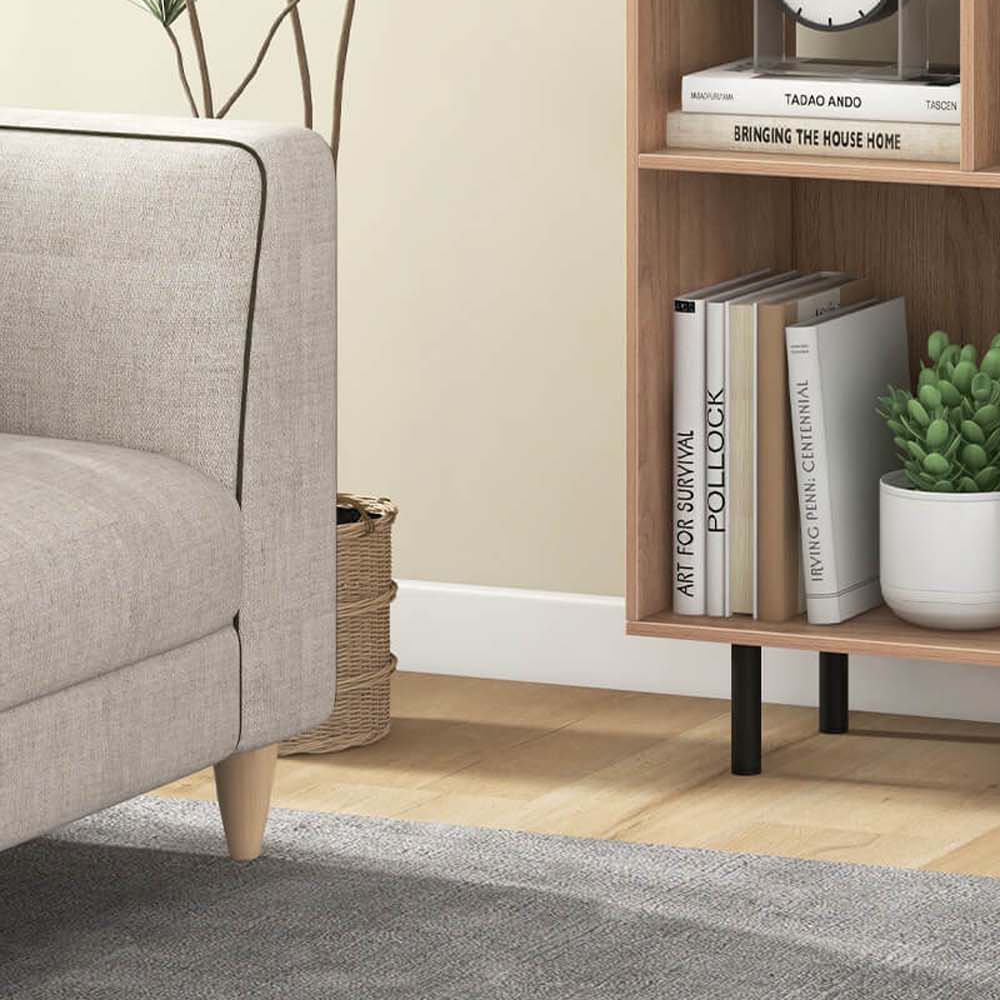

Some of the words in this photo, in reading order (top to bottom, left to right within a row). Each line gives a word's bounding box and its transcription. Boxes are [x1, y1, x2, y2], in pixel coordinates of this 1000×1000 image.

[785, 93, 825, 107] TADAO
[828, 95, 862, 109] ANDO
[734, 125, 792, 146] BRINGING
[796, 128, 820, 147] THE
[823, 130, 864, 149] HOUSE
[867, 132, 901, 151] HOME
[798, 378, 815, 473] CENTENNIAL
[677, 430, 694, 513] SURVIVAL
[707, 387, 725, 533] POLLOCK
[807, 477, 819, 521] PENN:
[677, 519, 694, 556] FOR
[809, 526, 824, 582] IRVING
[677, 563, 694, 597] ART
